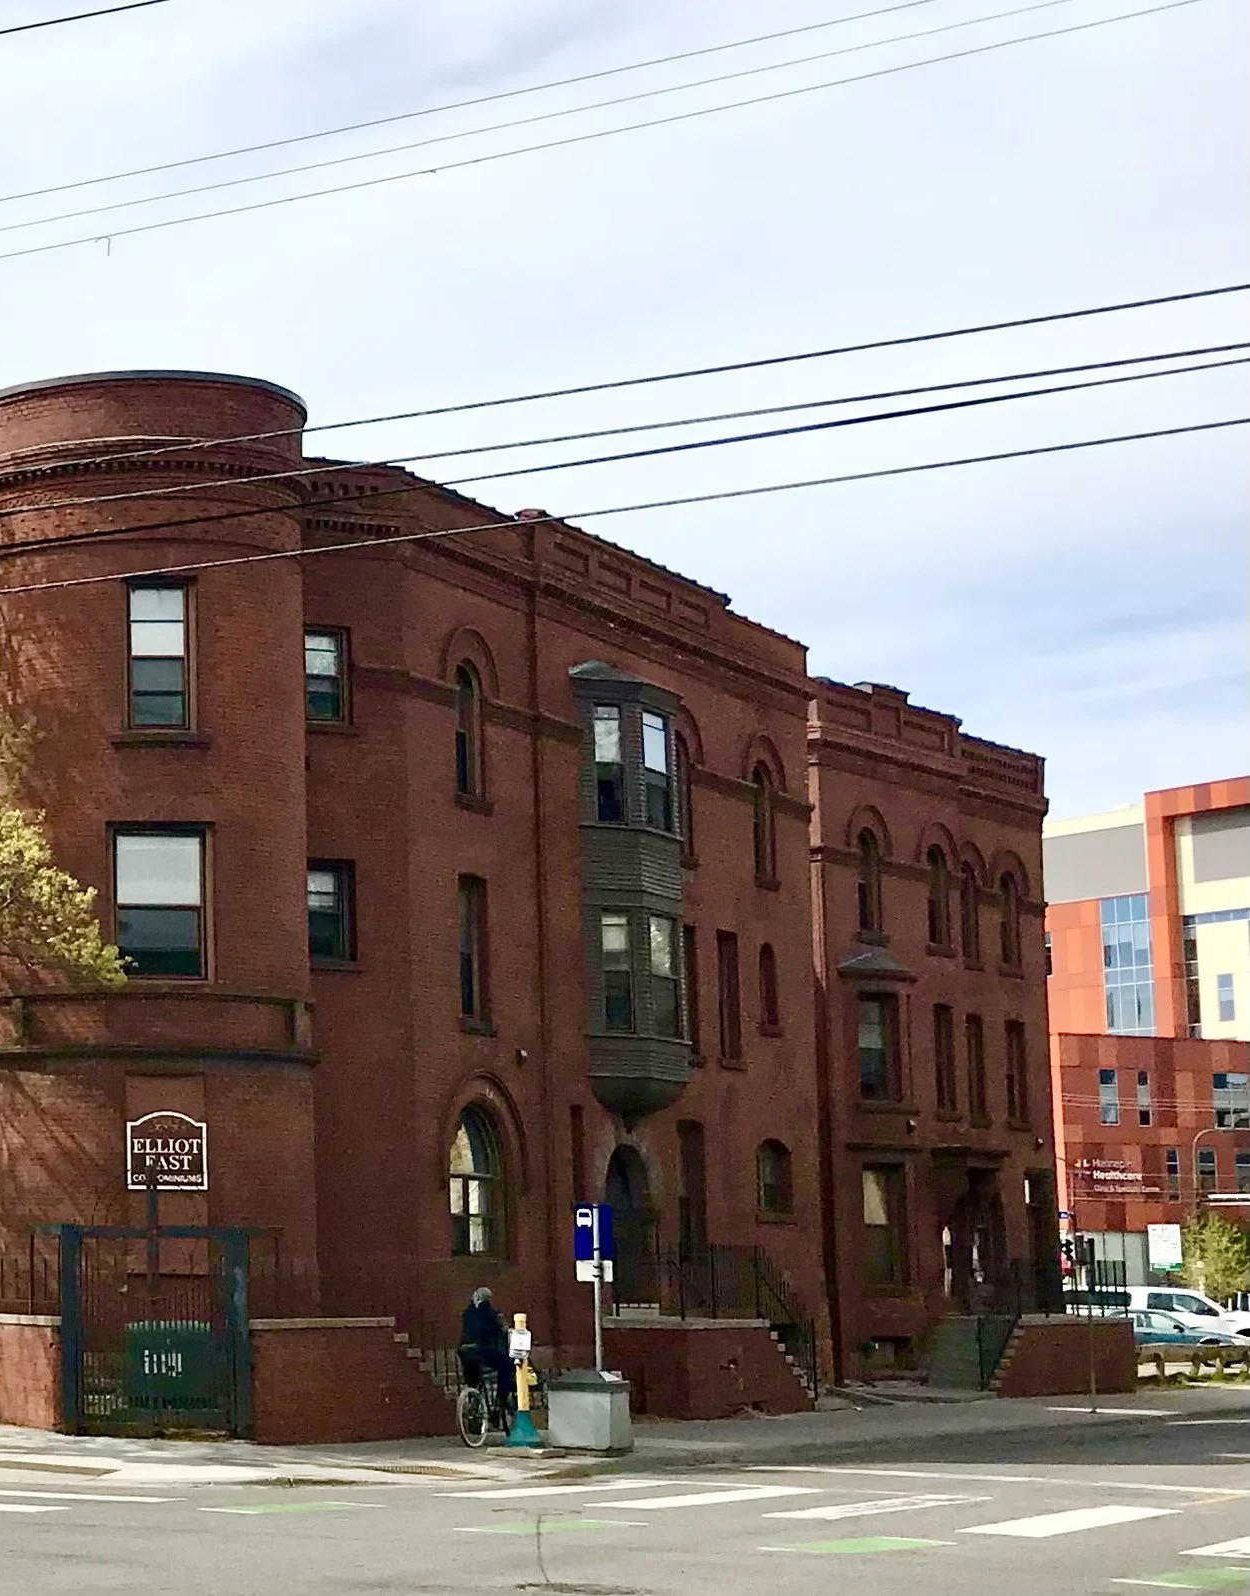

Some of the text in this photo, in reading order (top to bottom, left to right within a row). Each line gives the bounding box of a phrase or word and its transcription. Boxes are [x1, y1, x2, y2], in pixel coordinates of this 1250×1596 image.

[132, 1138, 202, 1154] ELLIOT
[145, 1155, 193, 1170] EAST
[132, 1173, 203, 1183] COOMINIUMS
[1092, 1170, 1143, 1181] Healthcare
